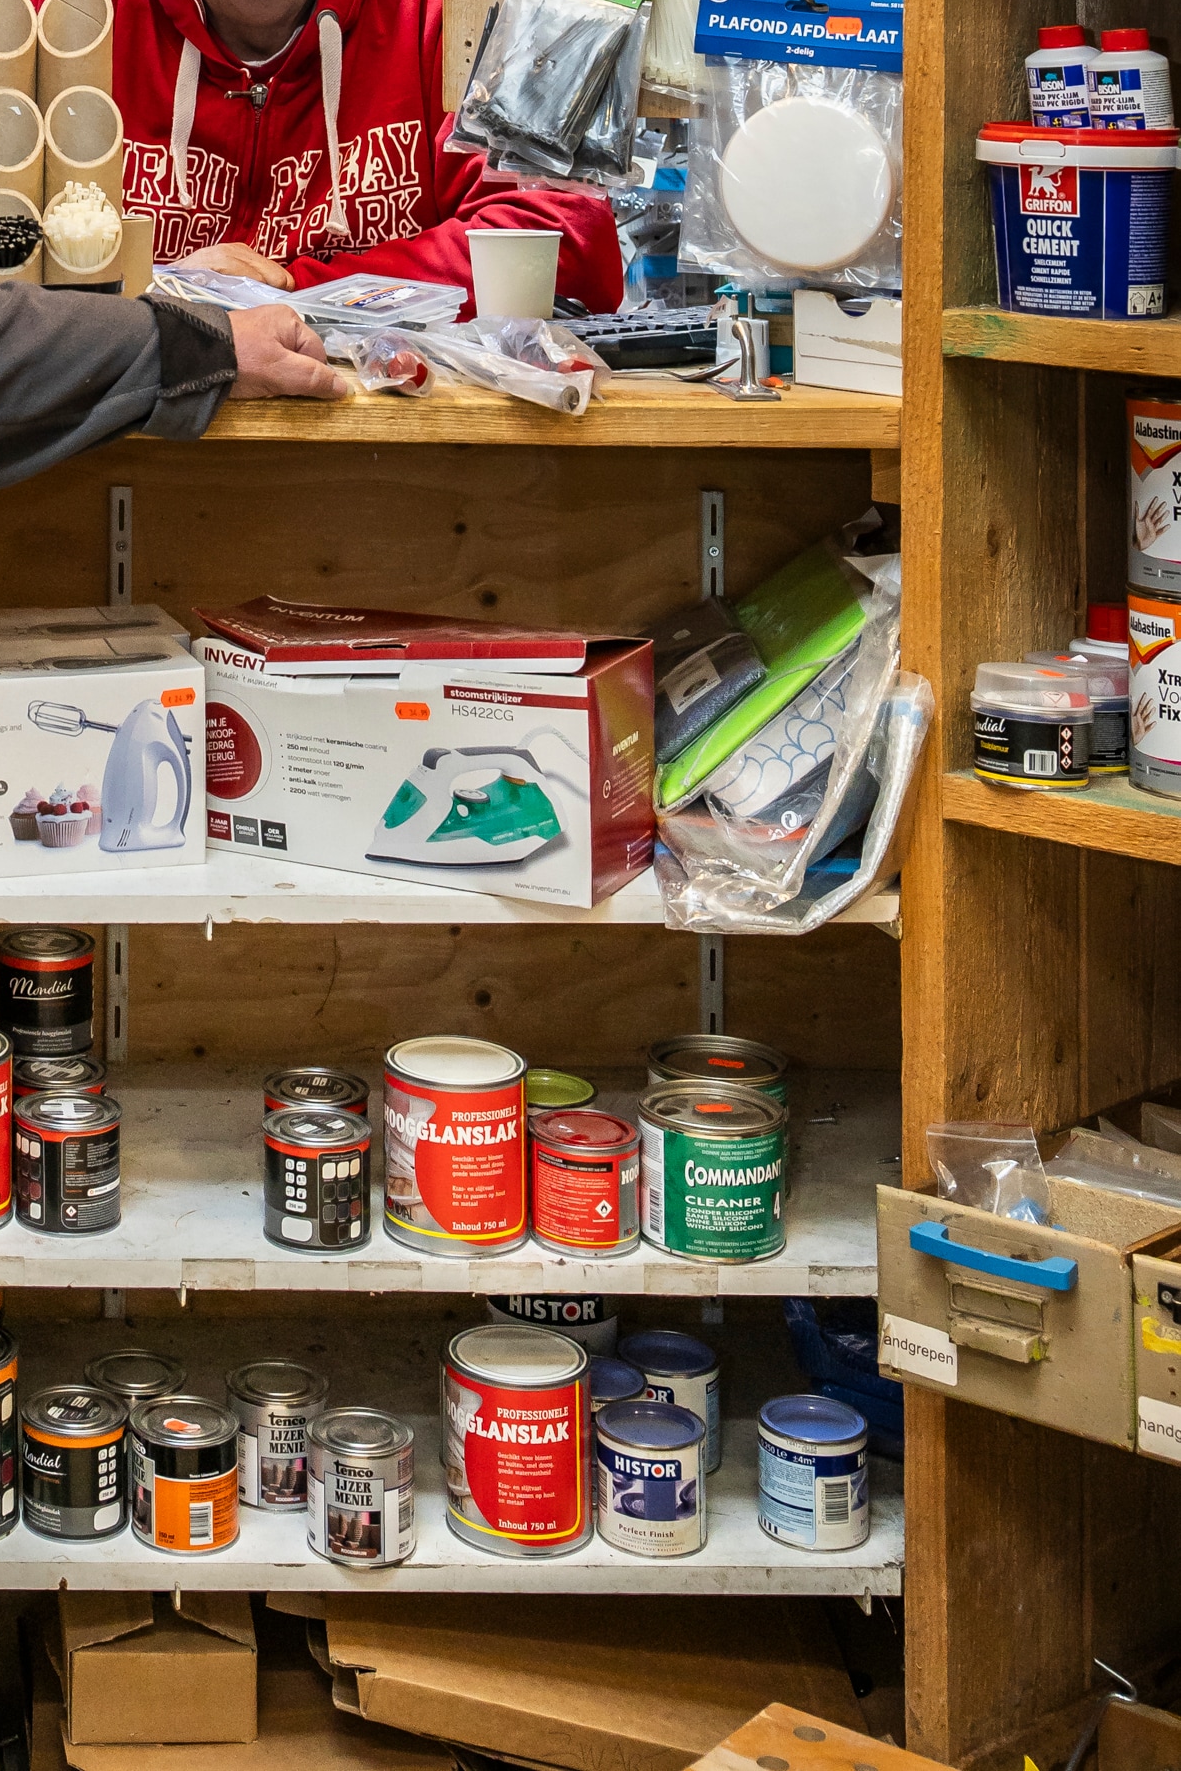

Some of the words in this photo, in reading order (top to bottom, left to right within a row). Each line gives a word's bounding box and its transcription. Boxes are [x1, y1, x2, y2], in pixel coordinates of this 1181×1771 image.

[708, 14, 788, 35] PLAFOND
[785, 45, 815, 58] 2-delig
[1047, 92, 1080, 101] PVC-LIJM
[1025, 199, 1072, 213] GRIFFON
[1026, 218, 1073, 238] QUICK
[1022, 237, 1080, 257] CEMENT
[1033, 258, 1067, 267] SNELCEMENT
[1031, 267, 1051, 276] CIMENT
[1051, 267, 1071, 276] RAPIDE
[1030, 275, 1072, 285] SCHNELLZEMENT
[268, 605, 366, 623] INVENTUM
[246, 678, 279, 689] moment
[450, 688, 523, 704] stoomstrijkijzer
[451, 703, 514, 722] HS422CG
[9, 723, 23, 732] and
[326, 737, 364, 749] keramische
[208, 750, 237, 762] TERUG!
[293, 766, 313, 775] meter
[288, 776, 317, 786] anti-kalk
[289, 787, 307, 795] 2200
[514, 881, 571, 896] www.inventum.eu
[9, 976, 73, 997] Mondial
[451, 1104, 517, 1123] PROFESSIONELE
[384, 1103, 517, 1147] HOOGGLANSLAK
[684, 1159, 782, 1189] COMMANDANT
[684, 1195, 762, 1208] CLEANER
[686, 1207, 723, 1216] ZONDER
[723, 1207, 765, 1216] SILICONEN
[451, 1220, 482, 1232] Inhoud
[685, 1222, 724, 1232] WITHOUT
[724, 1223, 764, 1232] SILICONS
[509, 1295, 595, 1322] HISTOR
[268, 1412, 307, 1427] tenco
[497, 1406, 569, 1421] PROFESSIONELE
[270, 1429, 305, 1441] IJZER
[269, 1442, 306, 1454] MENIE
[333, 1459, 374, 1478] tenco
[615, 1455, 679, 1478] HISTOR
[336, 1479, 372, 1494] IJZER
[334, 1492, 373, 1507] MENIE
[619, 1523, 647, 1537] Perfect
[649, 1529, 676, 1538] Finish
